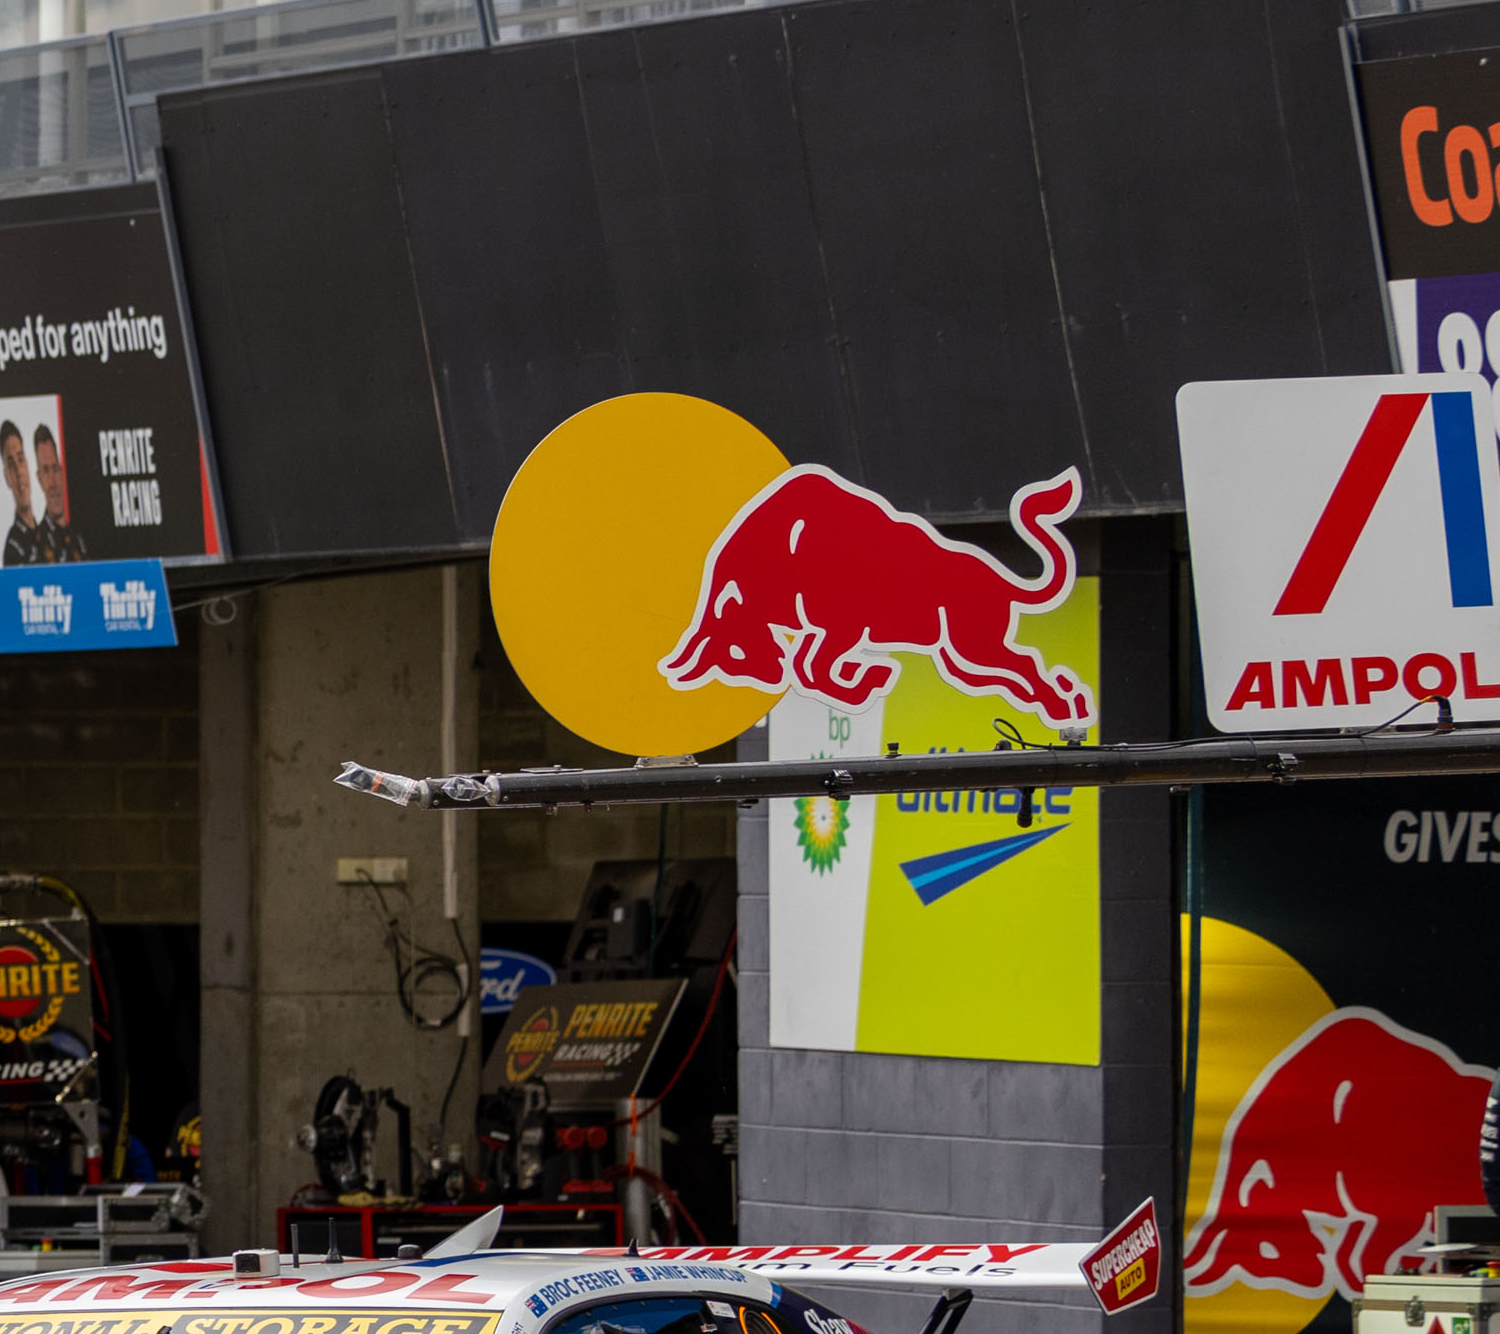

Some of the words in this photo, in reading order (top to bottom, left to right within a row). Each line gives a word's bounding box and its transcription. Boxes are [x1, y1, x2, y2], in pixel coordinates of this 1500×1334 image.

[34, 315, 68, 358] for
[71, 306, 168, 363] anything
[98, 428, 156, 476] PENRITE
[111, 480, 162, 527] RACING
[828, 710, 851, 747] bp
[563, 1002, 659, 1039] PENRITE
[556, 1043, 610, 1063] RACING
[840, 1260, 1018, 1278] Fuels
[1091, 1215, 1157, 1292] SUPERCHEAP
[540, 1278, 577, 1305] BROC
[577, 1268, 625, 1291] FEENEY
[644, 1266, 693, 1283] JAMIE
[695, 1265, 748, 1284] WHINCUP
[1118, 1266, 1146, 1297] AUTO
